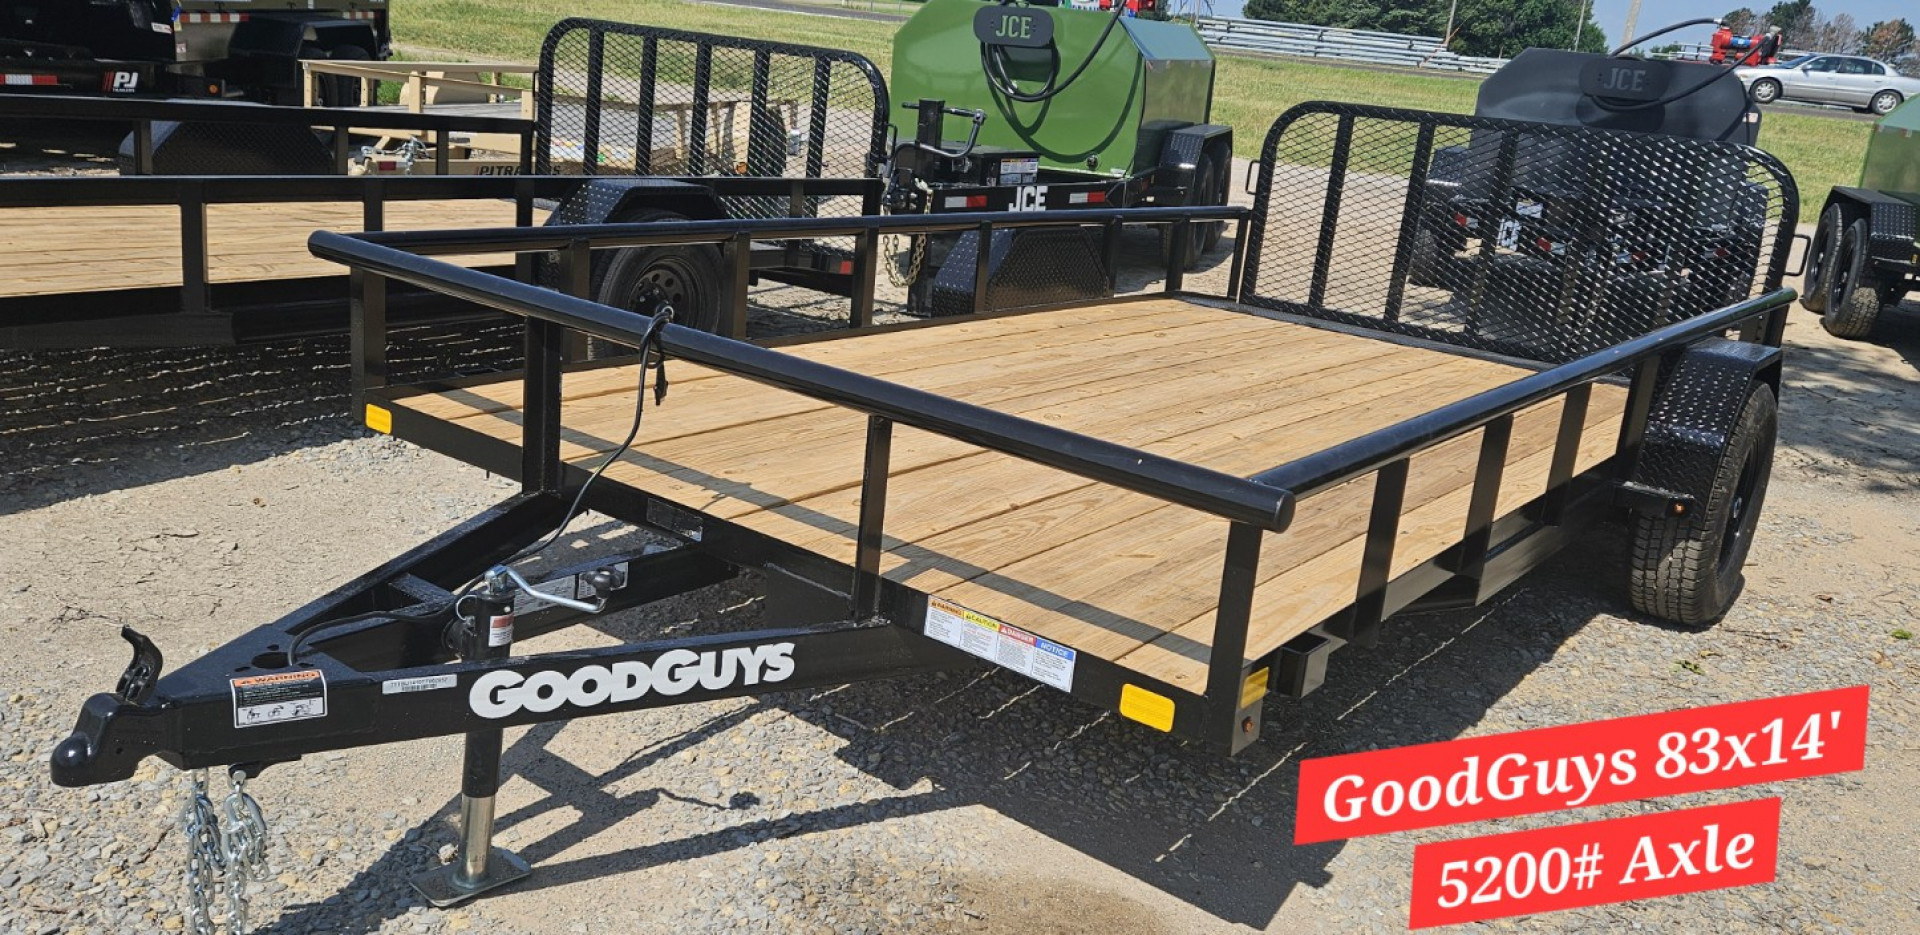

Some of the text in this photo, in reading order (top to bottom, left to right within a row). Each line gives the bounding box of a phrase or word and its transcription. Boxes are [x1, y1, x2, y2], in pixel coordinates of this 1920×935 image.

[996, 15, 1032, 39] JCE
[113, 71, 138, 88] PJ
[1603, 68, 1646, 92] JCE
[1008, 185, 1048, 212] JCE
[971, 614, 998, 629] CAUTION
[1007, 627, 1035, 643] DANGER
[1041, 642, 1069, 658] NOTICE
